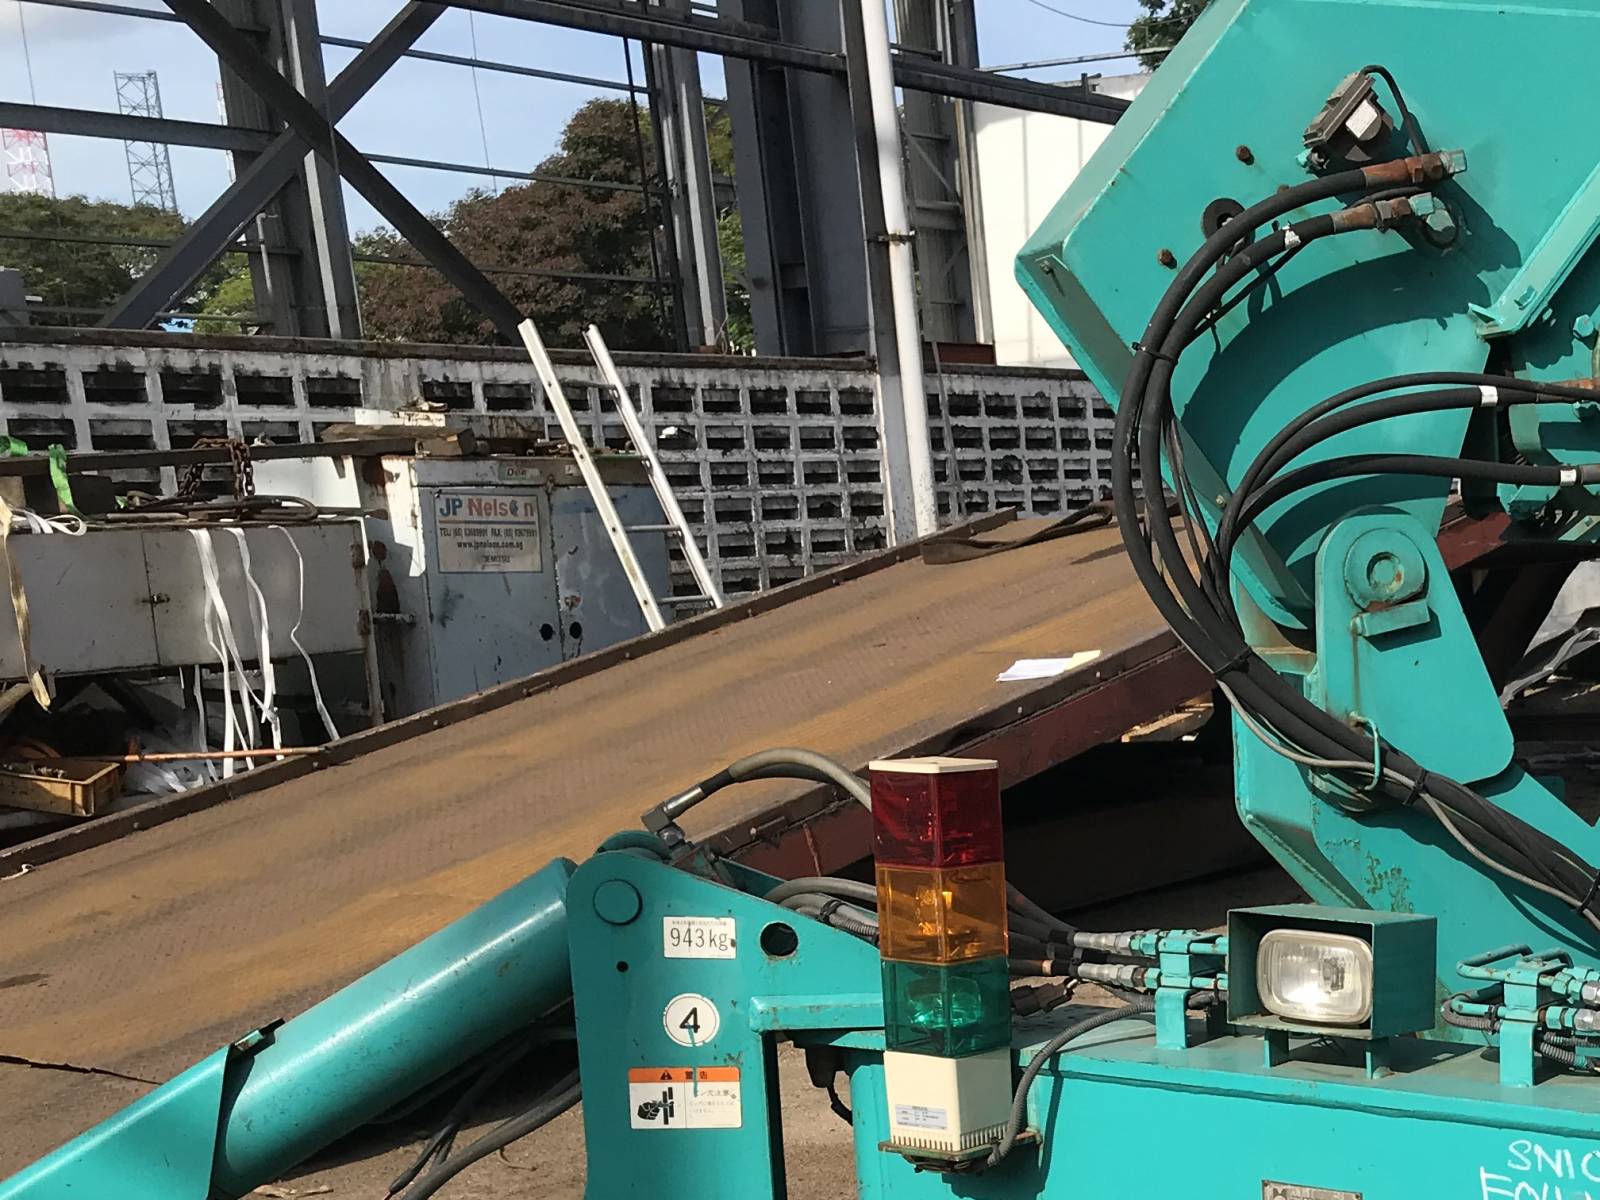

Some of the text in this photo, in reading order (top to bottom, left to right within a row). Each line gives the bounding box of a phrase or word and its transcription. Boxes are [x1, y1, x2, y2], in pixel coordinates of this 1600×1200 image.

[439, 498, 533, 516] JP Nelson
[680, 1007, 700, 1034] 4
